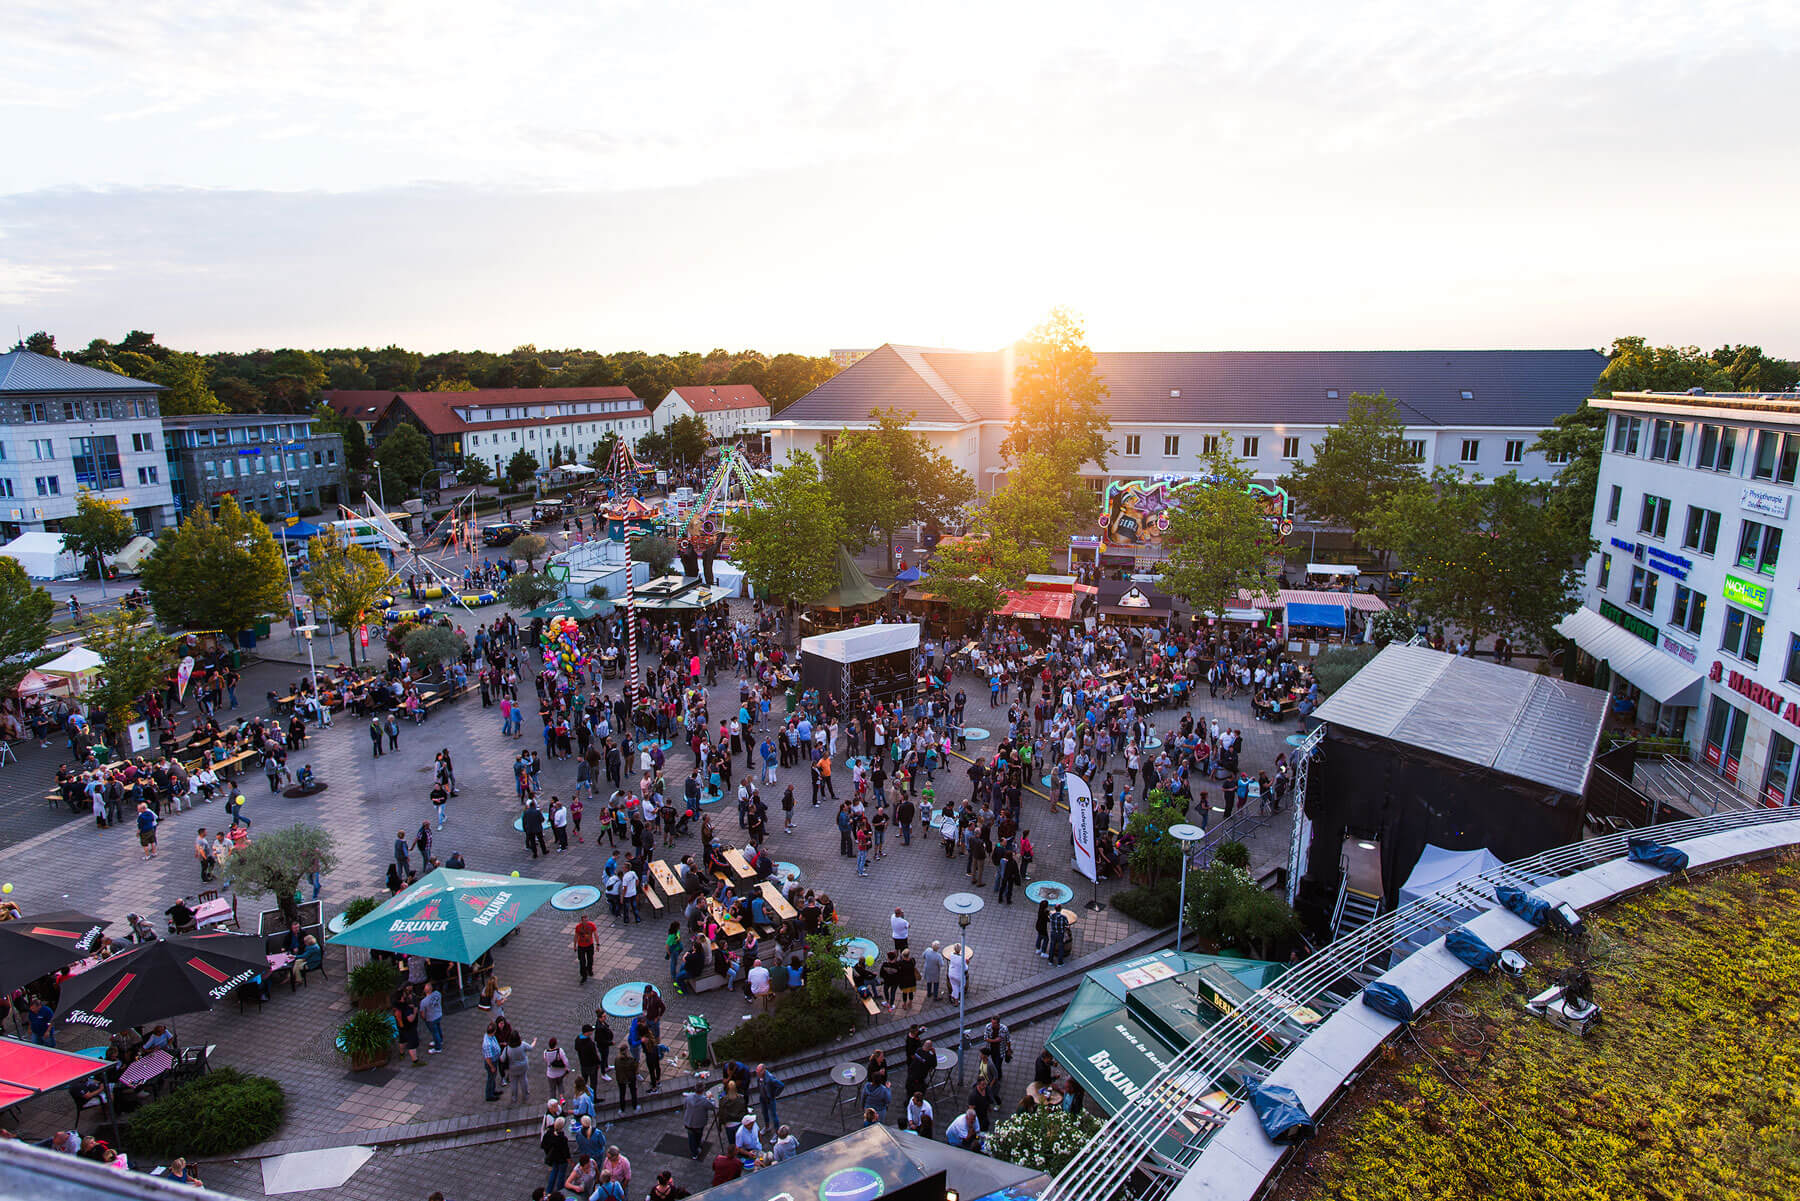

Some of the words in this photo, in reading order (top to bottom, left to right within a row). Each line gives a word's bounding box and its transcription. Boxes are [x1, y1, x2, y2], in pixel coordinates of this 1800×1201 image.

[1728, 670, 1784, 715] MARKT
[472, 891, 512, 927] BERLINER
[389, 919, 449, 932] BERLINER
[209, 969, 254, 1000] Köstritzer
[65, 1009, 113, 1028] Köstritzer
[1114, 1024, 1139, 1044] Made
